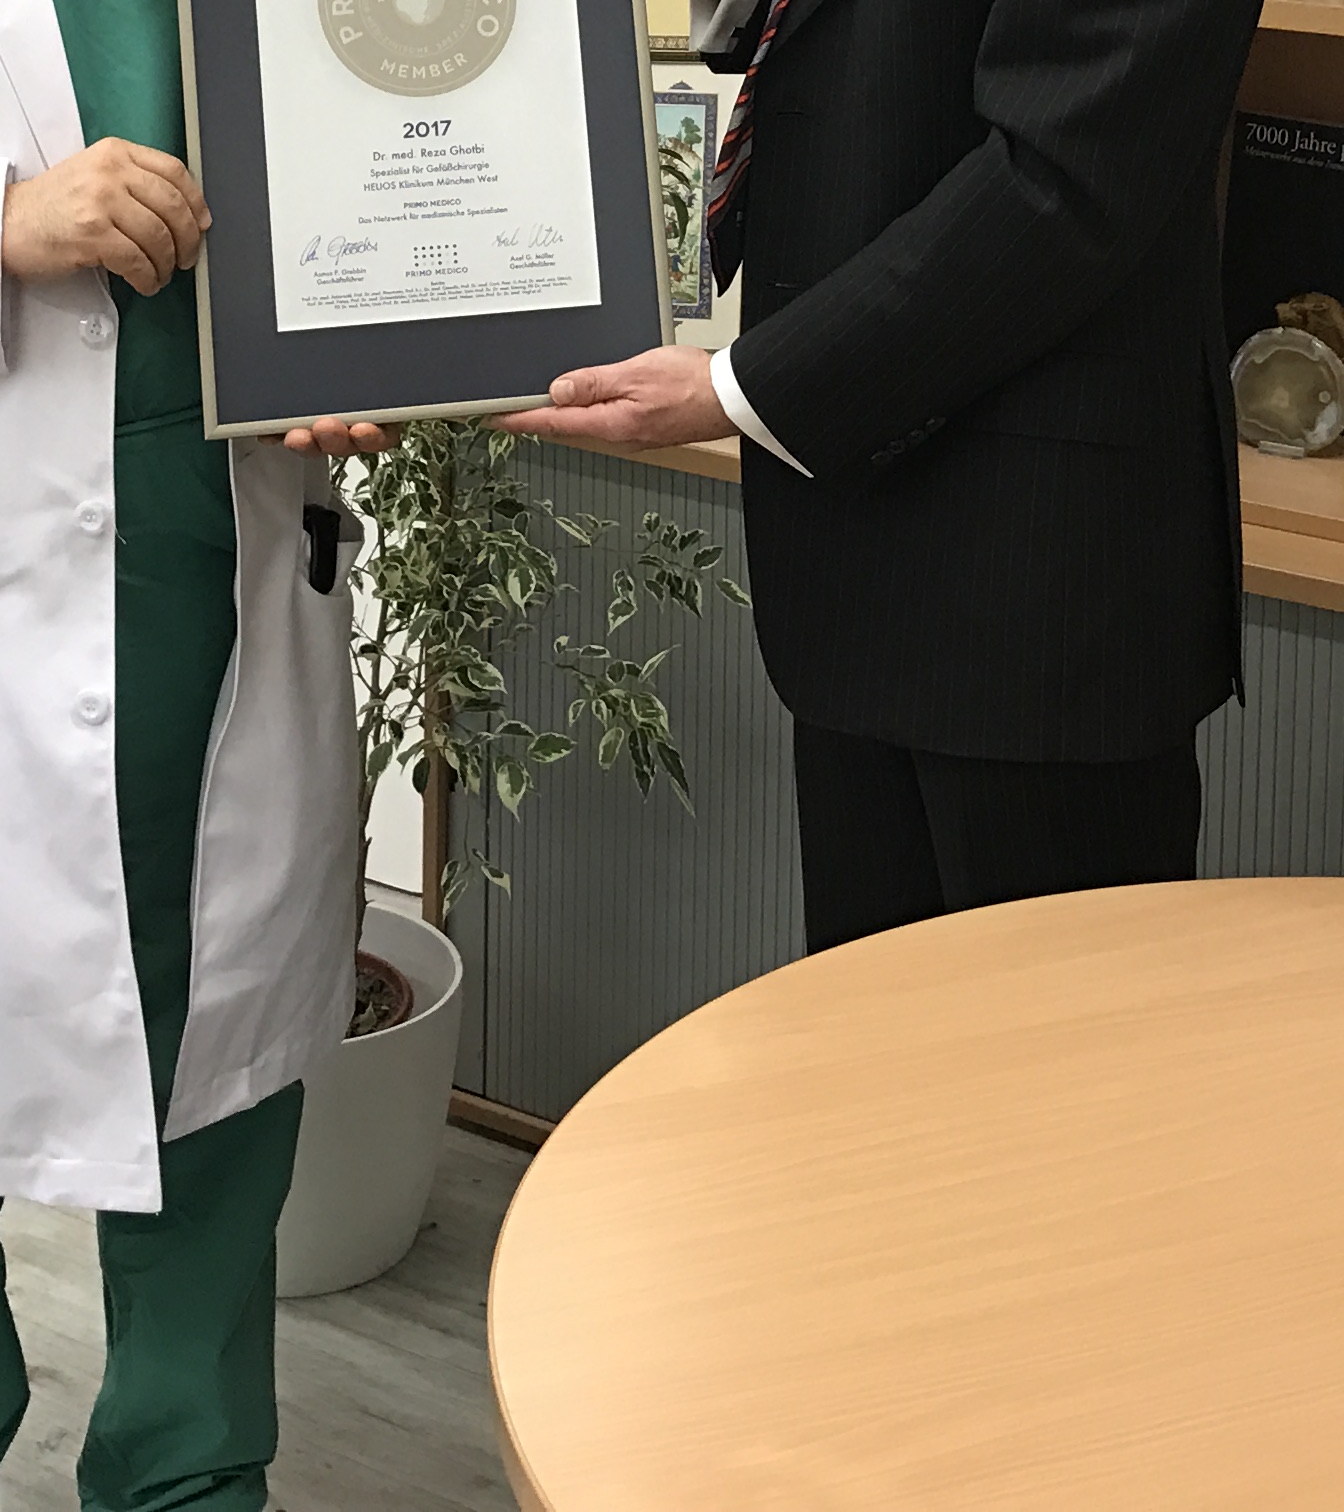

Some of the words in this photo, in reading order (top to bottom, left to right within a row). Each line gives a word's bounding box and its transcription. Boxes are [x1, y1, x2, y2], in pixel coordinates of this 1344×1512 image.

[380, 52, 468, 79] MEMBER
[403, 120, 451, 138] 2017
[1245, 122, 1289, 146] 7000
[1291, 130, 1336, 154] Jahre
[373, 152, 388, 161] Dr.
[392, 149, 416, 159] med.
[421, 148, 446, 158] Reza
[450, 144, 485, 155] Ghotbi
[370, 168, 410, 179] Spezialist
[426, 161, 489, 173] Gefäßchirurgie
[364, 182, 396, 191] HELIOS
[399, 180, 434, 189] Klinikum
[437, 178, 475, 187] München
[477, 175, 498, 183] West
[430, 198, 461, 207] MEDICO
[374, 214, 407, 222] Netzwerk
[405, 269, 432, 277] PRIMO
[435, 266, 468, 275] MEDICO
